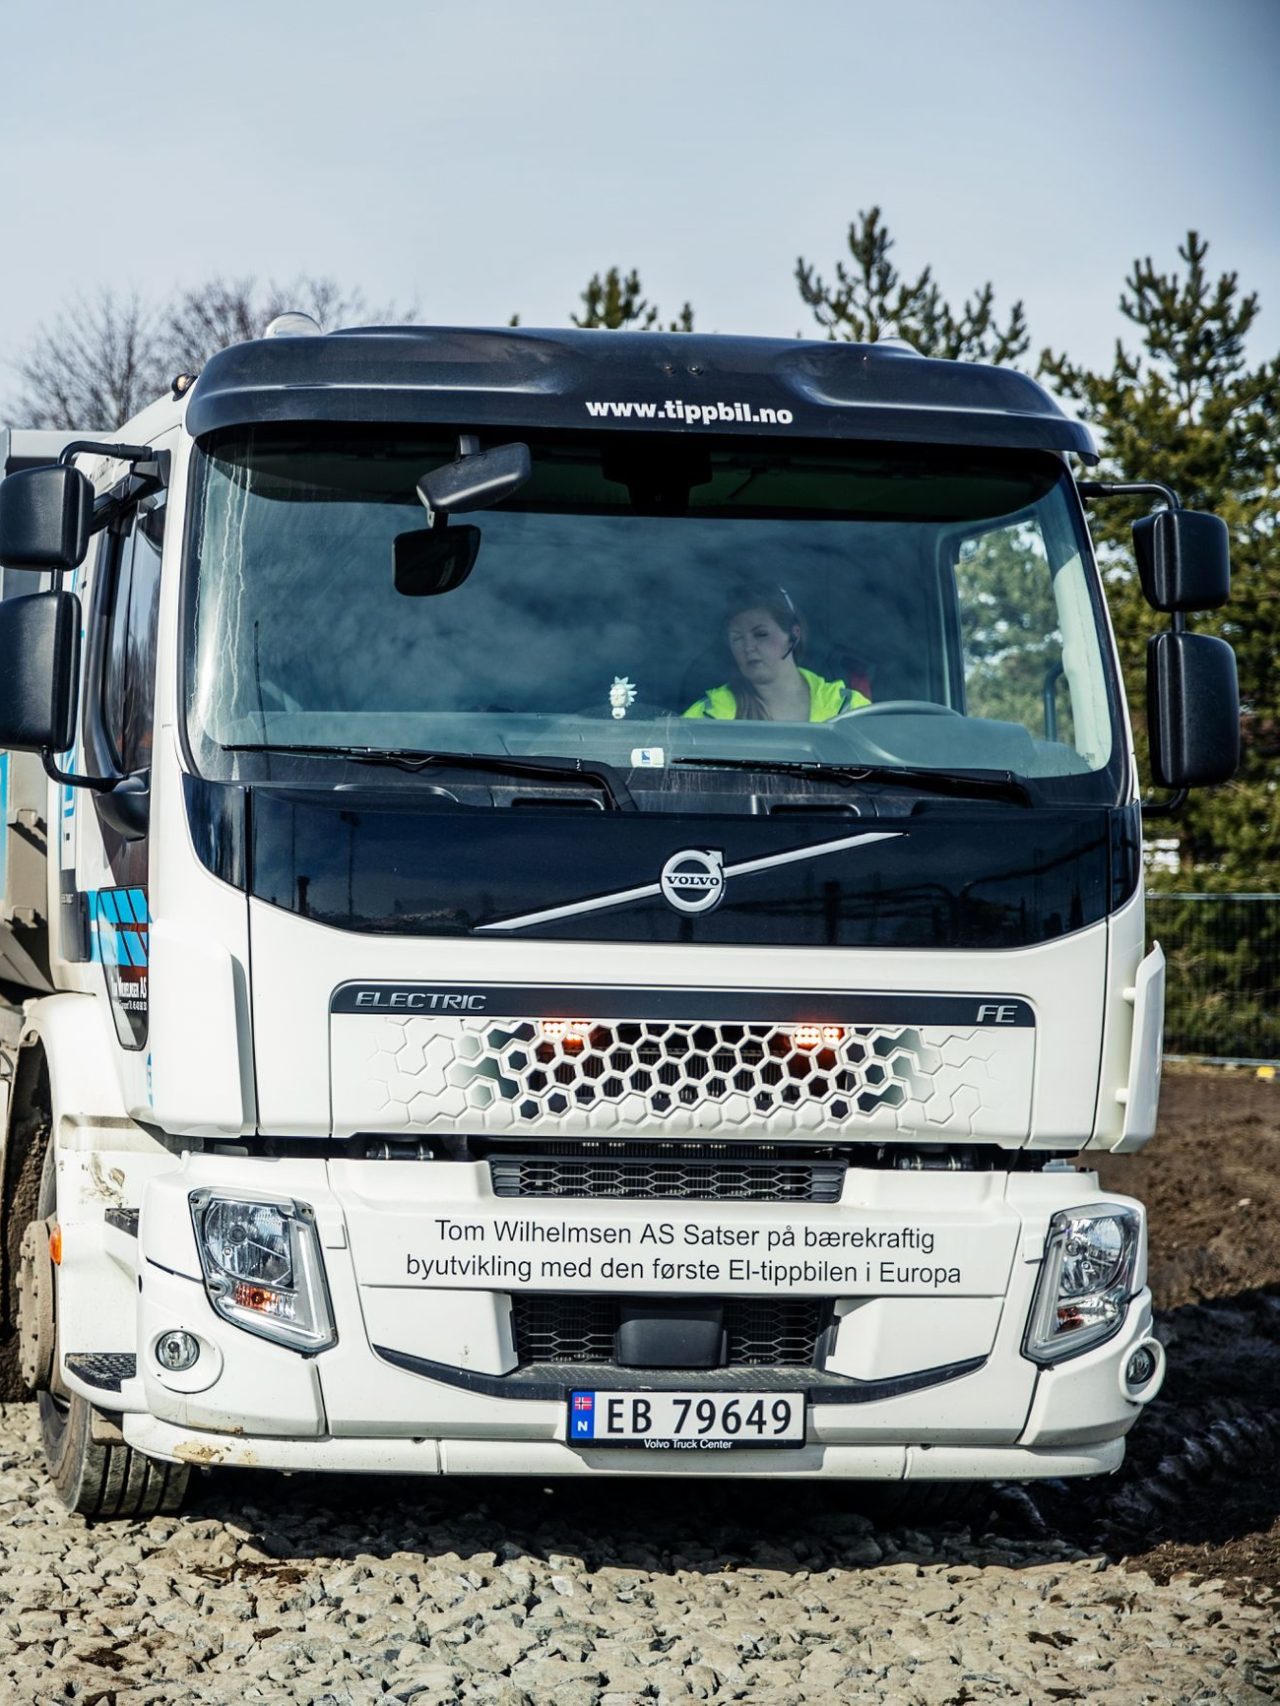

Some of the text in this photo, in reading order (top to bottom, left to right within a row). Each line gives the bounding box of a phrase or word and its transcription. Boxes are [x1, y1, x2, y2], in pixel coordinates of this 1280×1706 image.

[585, 400, 794, 425] www.tippbil.no
[665, 875, 720, 886] VOLVO
[355, 991, 487, 1010] ELECTRIC
[976, 1004, 1018, 1023] FE
[435, 1219, 934, 1254] Tom Wilhelmsen AS Satser på bærekraftig
[406, 1253, 961, 1288] byutvikling med den første El-tippbilen i Europa
[577, 1420, 588, 1431] N
[607, 1398, 792, 1435] EB 79649
[644, 1438, 733, 1449] Volvo Truck Center
